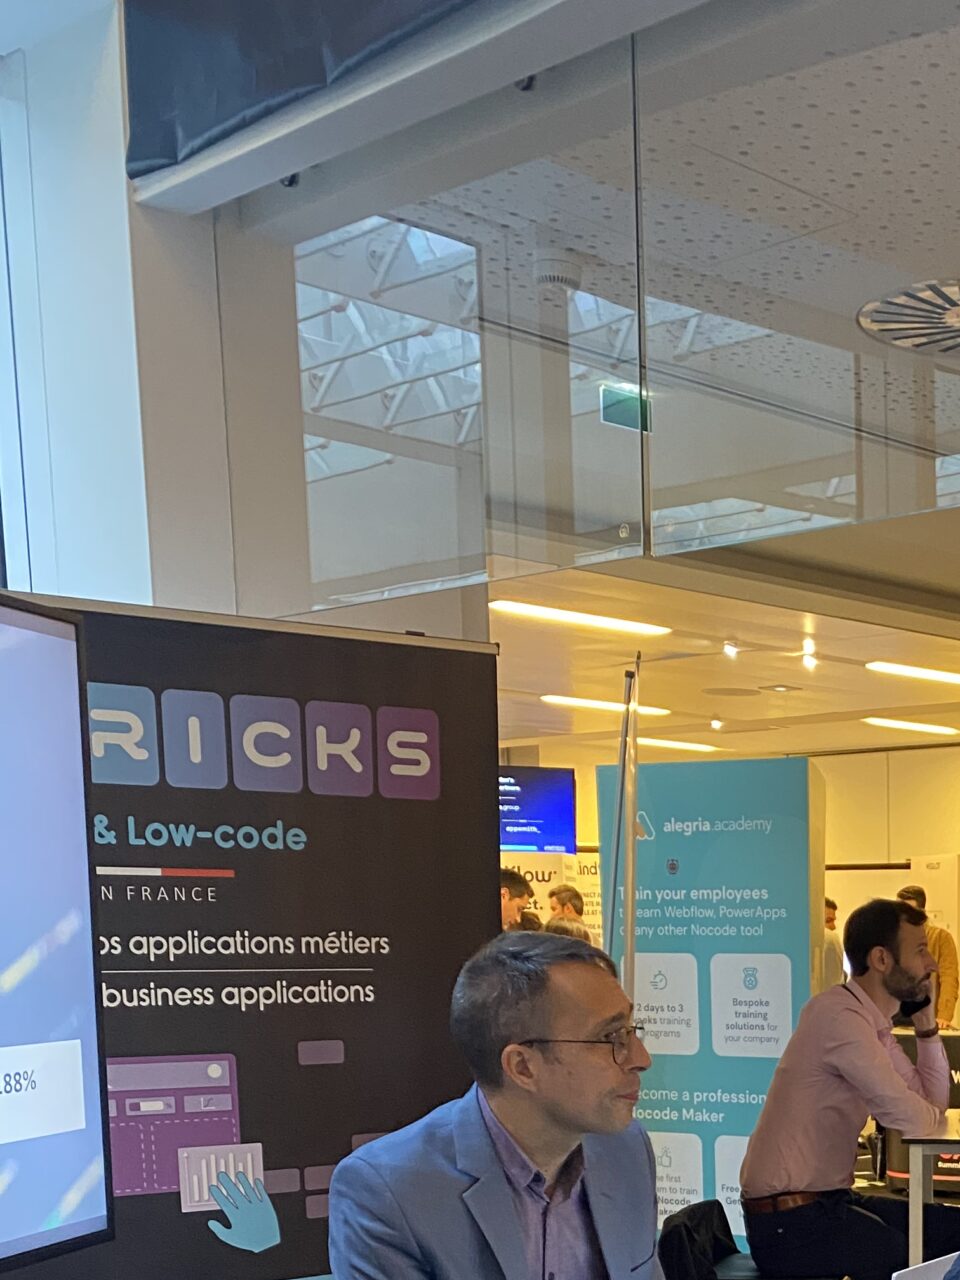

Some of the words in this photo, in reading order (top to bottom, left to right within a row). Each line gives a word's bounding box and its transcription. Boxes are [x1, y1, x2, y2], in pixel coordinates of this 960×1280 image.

[89, 708, 432, 777] RICKS
[94, 813, 117, 845] &
[128, 816, 307, 851] Low-code
[663, 815, 773, 837] alegria.academy
[126, 886, 219, 902] FRANCE
[617, 886, 651, 901] Tain
[655, 888, 686, 904] your
[690, 885, 769, 904] employees
[636, 908, 661, 918] earn
[664, 906, 716, 919] Webflow,
[719, 906, 787, 920] PowerApps
[635, 927, 657, 938] any
[657, 924, 687, 936] other
[691, 924, 737, 936] Nocode
[741, 924, 763, 936] tool
[128, 929, 295, 961] applications
[301, 930, 390, 956] métiers
[101, 982, 214, 1007] business
[221, 980, 375, 1011] applications
[636, 1003, 642, 1012] 2
[644, 1003, 664, 1014] days
[667, 1003, 676, 1012] to
[678, 1003, 684, 1013] 3
[732, 997, 770, 1009] Bespoke
[660, 1016, 692, 1028] training
[735, 1010, 768, 1021] training
[725, 1021, 765, 1032] solutions
[767, 1022, 778, 1032] for
[643, 1029, 681, 1040] rograms
[724, 1035, 742, 1044] your
[743, 1034, 779, 1045] company
[682, 1090, 689, 1101] a
[683, 1107, 725, 1122] Maker
[669, 1186, 677, 1194] to
[679, 1186, 698, 1196] train
[721, 1183, 740, 1193] Free
